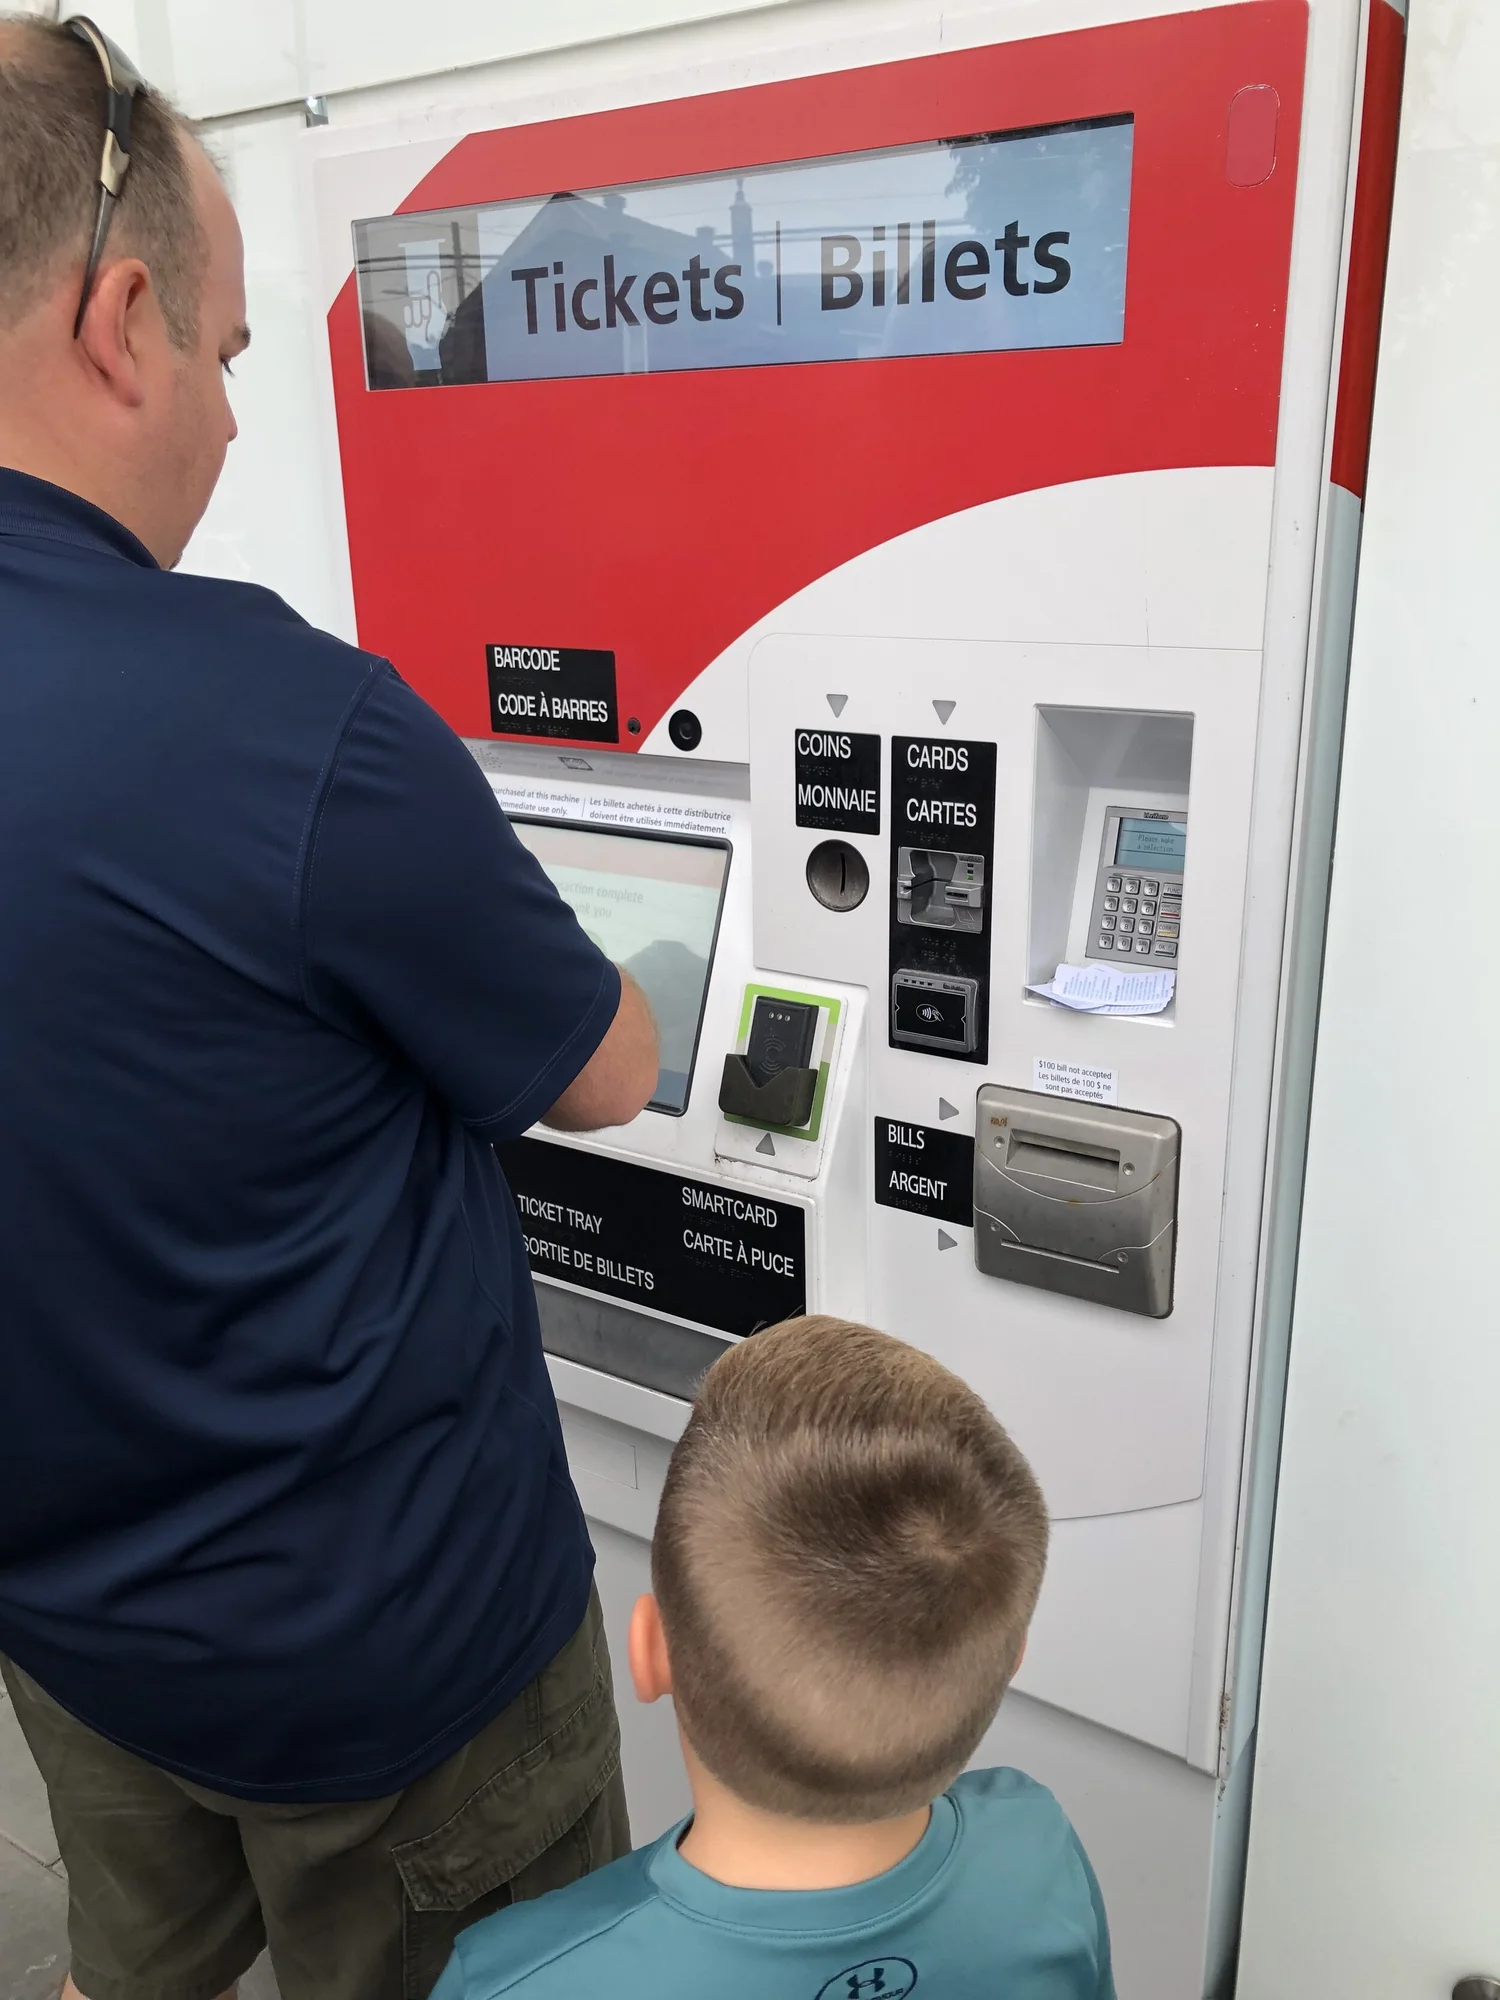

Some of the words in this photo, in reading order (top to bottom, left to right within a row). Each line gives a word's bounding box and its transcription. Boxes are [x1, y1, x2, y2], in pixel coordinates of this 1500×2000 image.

[511, 254, 746, 335] Tickets
[820, 220, 1071, 311] Billets
[494, 646, 561, 672] BARCODE
[498, 693, 536, 716] CODE
[540, 691, 550, 718] À
[552, 697, 608, 723] BARRES
[797, 732, 852, 760] COINS
[906, 744, 969, 772] CARDS
[500, 801, 536, 812] immediate
[551, 806, 568, 816] only.
[536, 791, 549, 800] this
[550, 793, 580, 804] machine
[589, 798, 602, 806] Les
[602, 798, 625, 809] billets
[626, 802, 656, 812] achetés
[656, 804, 662, 813] à
[663, 806, 683, 816] cette
[684, 808, 732, 821] distributrice
[798, 783, 876, 813] MONNAIE
[589, 810, 618, 821] doivent
[619, 814, 634, 824] être
[636, 816, 662, 826] utilisés
[664, 818, 727, 834] immédiatement.
[906, 798, 977, 828] CARTES
[1138, 834, 1158, 843] Please
[1143, 844, 1174, 852] selection
[560, 882, 594, 896] saction
[596, 886, 644, 904] complete
[593, 905, 612, 918] you
[1038, 1060, 1056, 1070] $100
[1057, 1064, 1068, 1072] bill
[1082, 1069, 1112, 1080] accepted
[1038, 1072, 1050, 1080] Les
[1050, 1074, 1070, 1084] billets
[1072, 1078, 1080, 1086] de
[1082, 1080, 1095, 1088] 100
[1096, 1082, 1101, 1090] $
[1045, 1083, 1060, 1092] sont
[1074, 1088, 1104, 1100] acceptés
[888, 1124, 925, 1150] BILLS
[888, 1170, 948, 1200] ARGENT
[517, 1194, 564, 1223] TICKET
[566, 1208, 602, 1234] TRAY
[682, 1186, 778, 1228] SMARTCARD
[683, 1229, 734, 1260] CARTE
[736, 1239, 748, 1265] À
[752, 1247, 794, 1278] PUCE
[574, 1250, 594, 1272] DE
[596, 1256, 655, 1290] BILLETS
